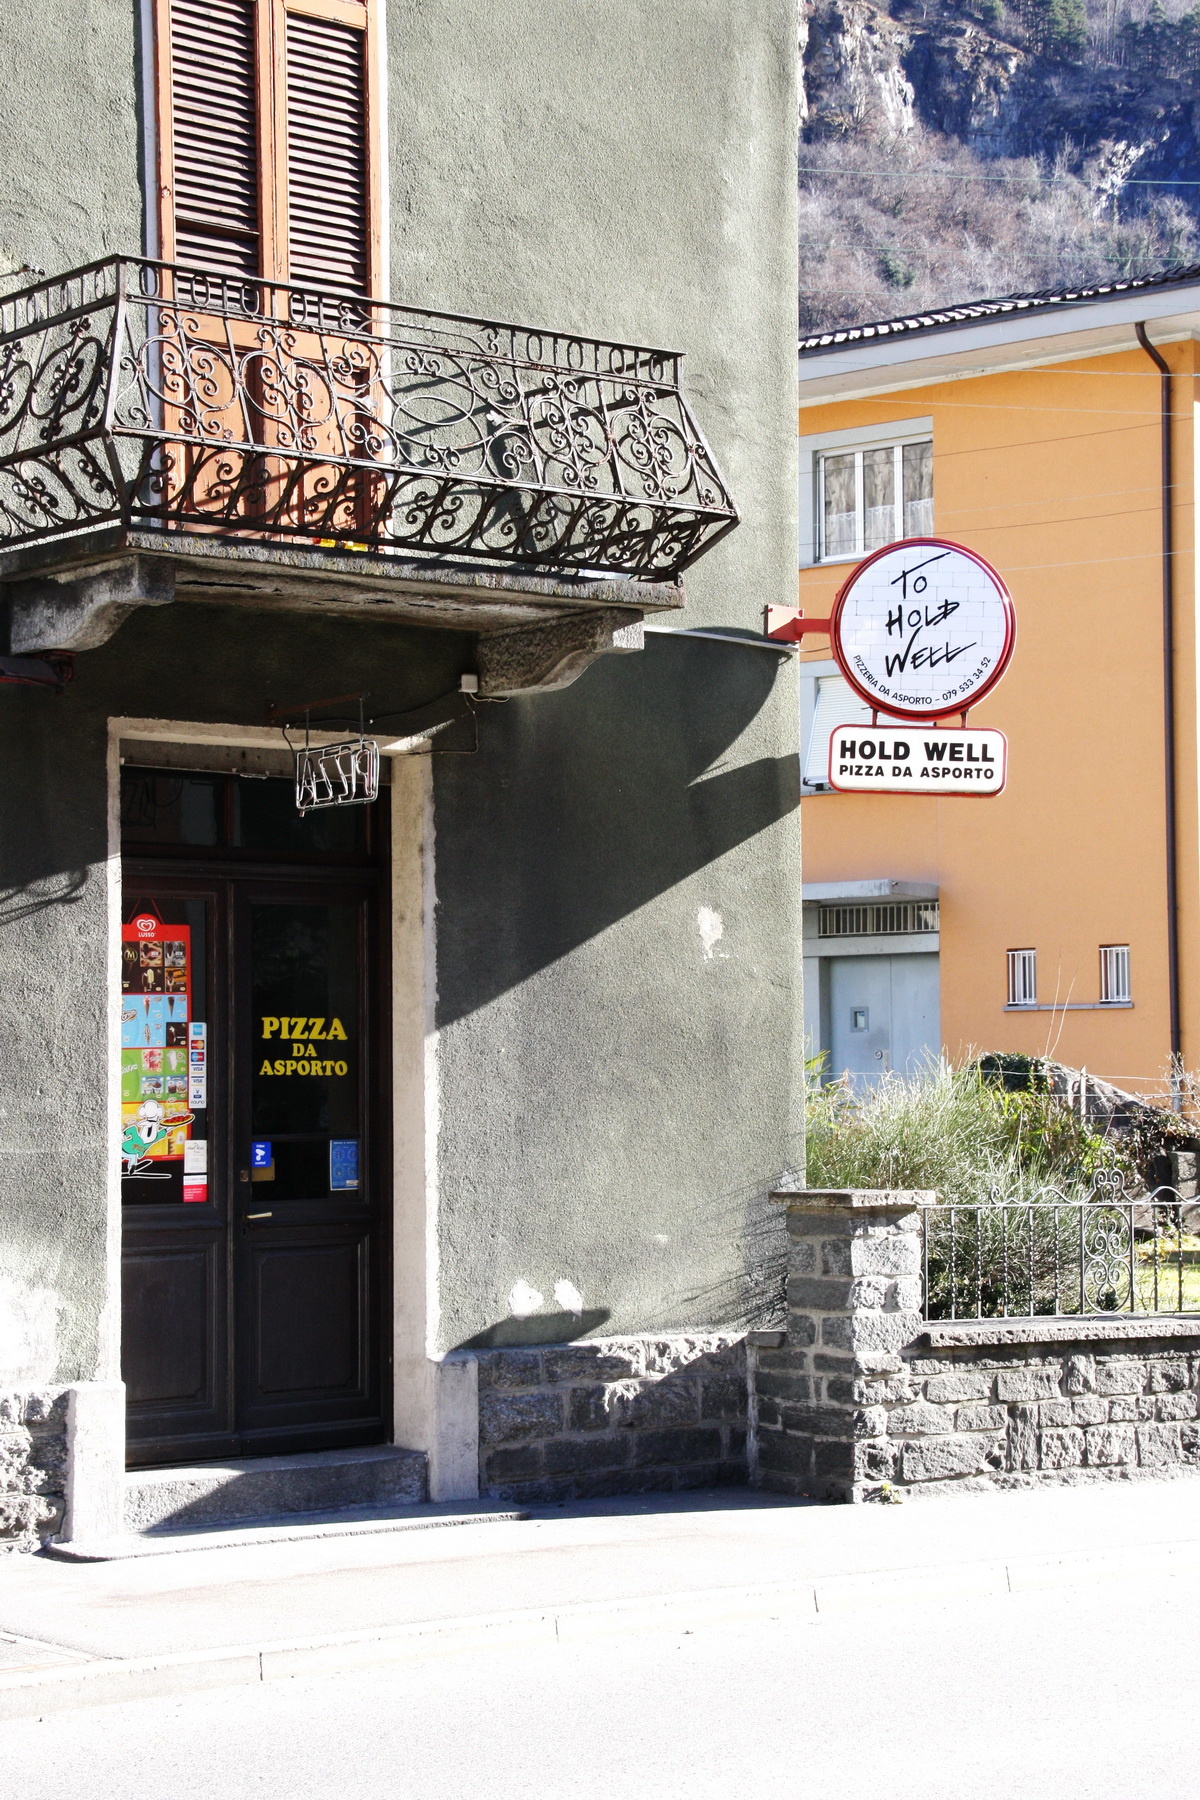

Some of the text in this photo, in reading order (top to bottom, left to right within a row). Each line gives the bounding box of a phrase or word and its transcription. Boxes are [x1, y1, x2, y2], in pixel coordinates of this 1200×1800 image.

[885, 598, 960, 638] HOLD
[885, 625, 977, 678] WELL
[853, 654, 879, 688] PIZZERIA
[878, 684, 890, 697] DA
[891, 692, 933, 705] ASPORTO
[942, 689, 958, 701] 079
[959, 678, 974, 693] 533
[972, 668, 985, 680] 34
[981, 656, 992, 670] 52
[840, 740, 995, 762] HOLD WELL
[839, 765, 994, 779] PIZZA DA ASPORTO
[261, 1016, 348, 1040] PIZZA
[292, 1043, 318, 1057] DA
[259, 1060, 348, 1076] ASPORTO
